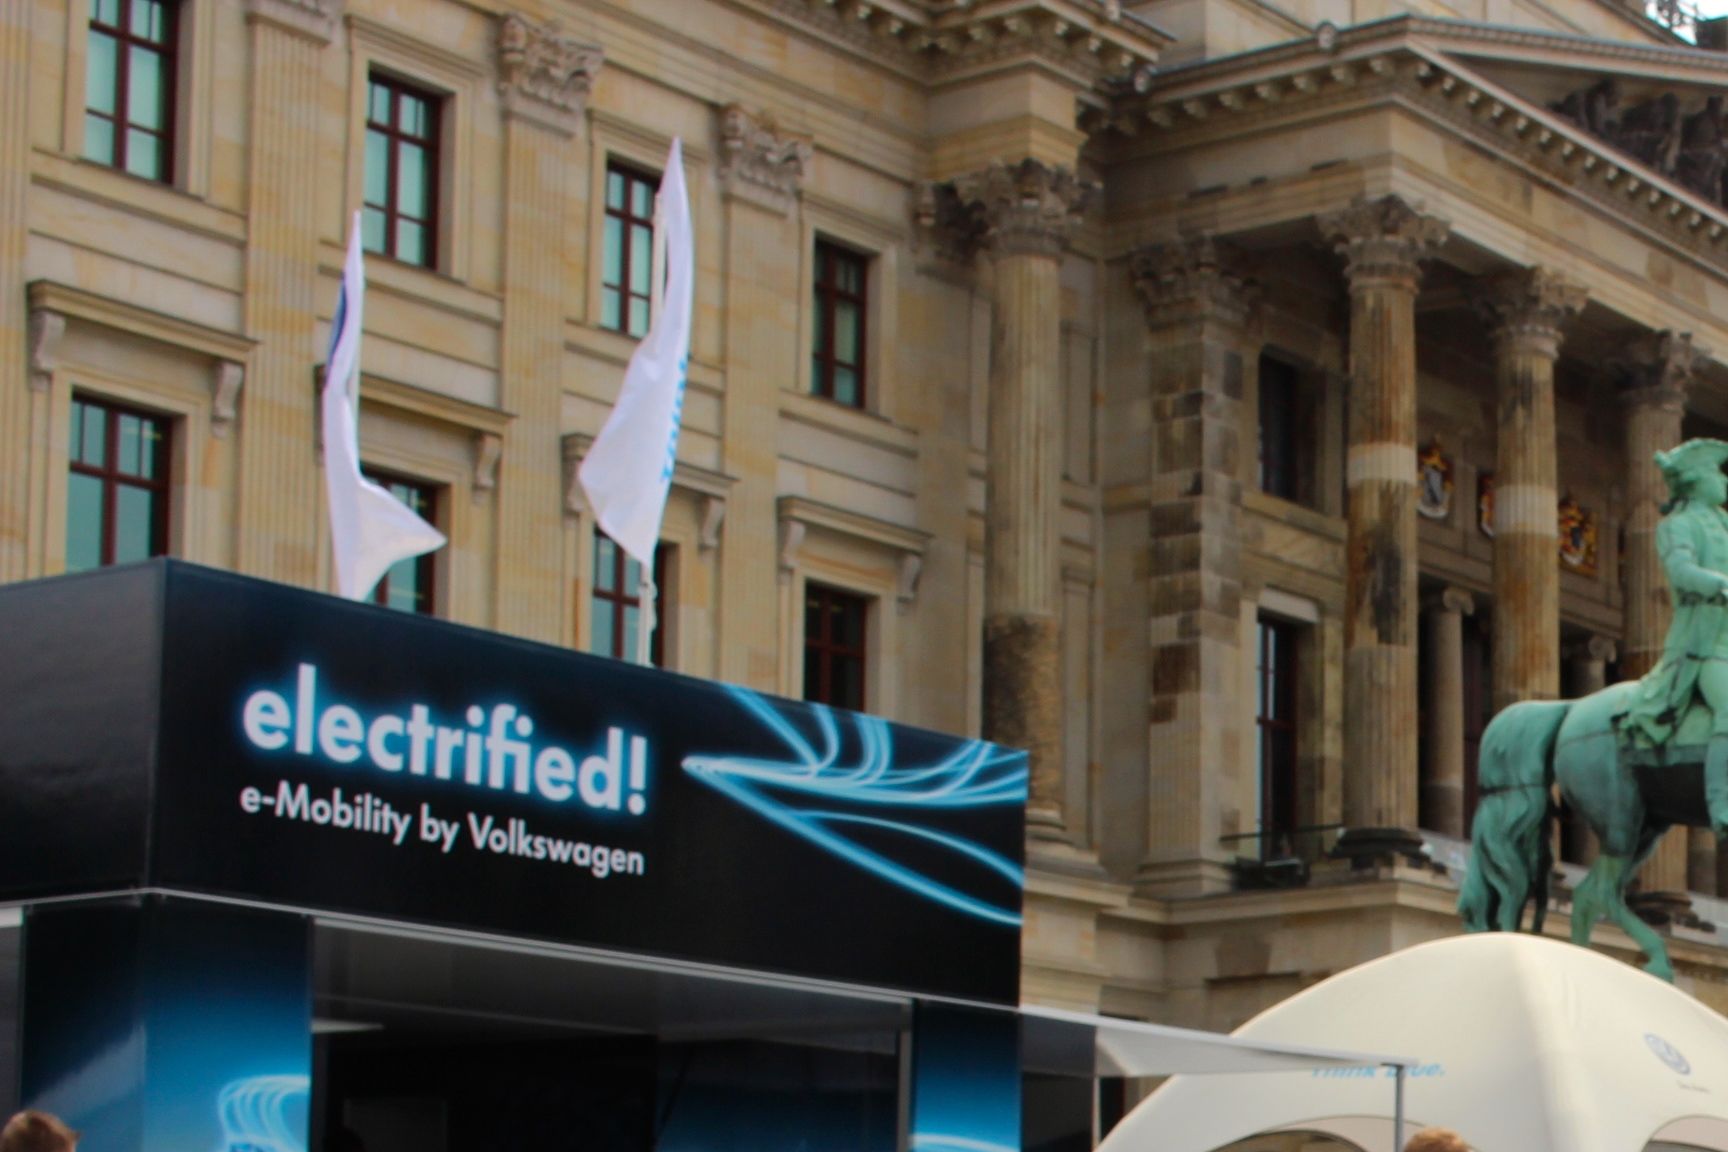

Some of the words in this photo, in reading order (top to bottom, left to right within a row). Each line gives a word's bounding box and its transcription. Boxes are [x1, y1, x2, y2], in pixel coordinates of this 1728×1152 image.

[242, 662, 648, 816] electrified!
[240, 779, 411, 845] e-Mobility
[419, 803, 460, 854] by
[467, 811, 645, 879] Volkswagen
